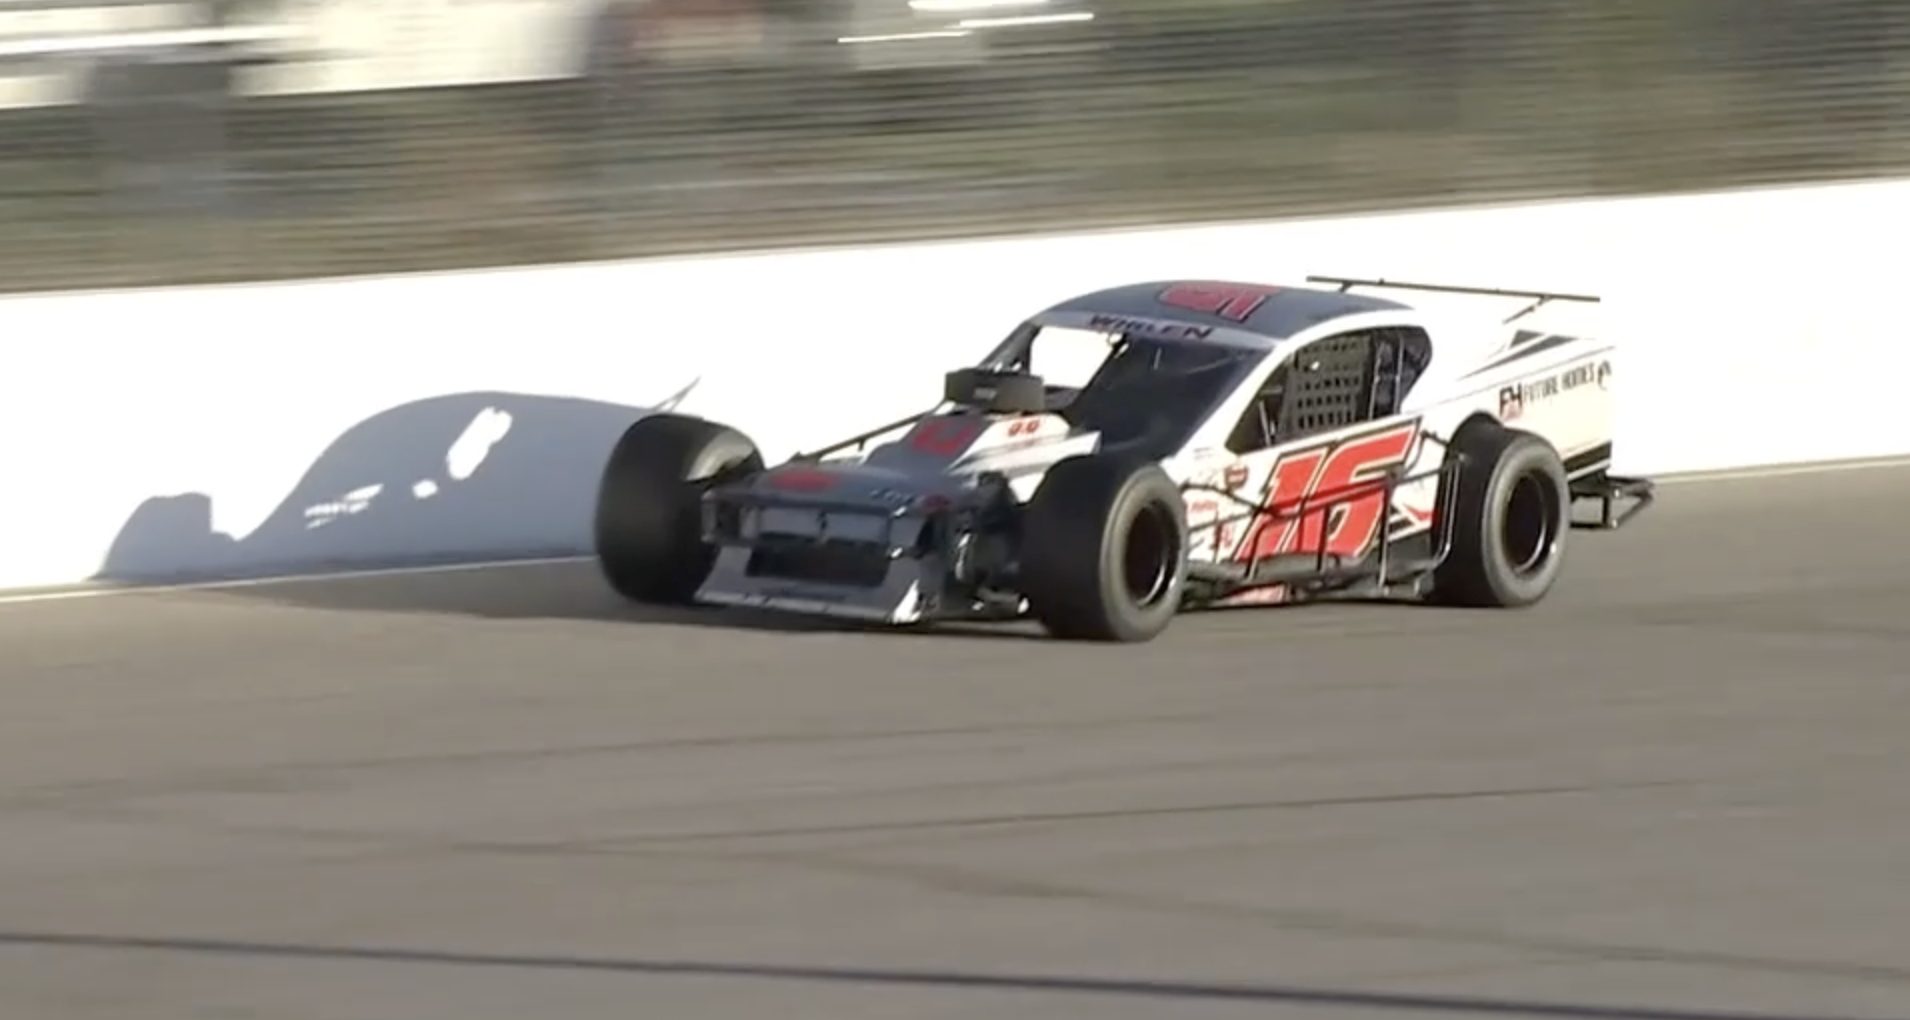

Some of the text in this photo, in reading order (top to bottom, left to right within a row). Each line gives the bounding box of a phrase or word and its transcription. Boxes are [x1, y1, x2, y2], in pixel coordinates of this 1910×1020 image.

[1523, 375, 1559, 402] FUTURE
[1561, 361, 1595, 391] HOMES
[1233, 420, 1418, 563] 16
